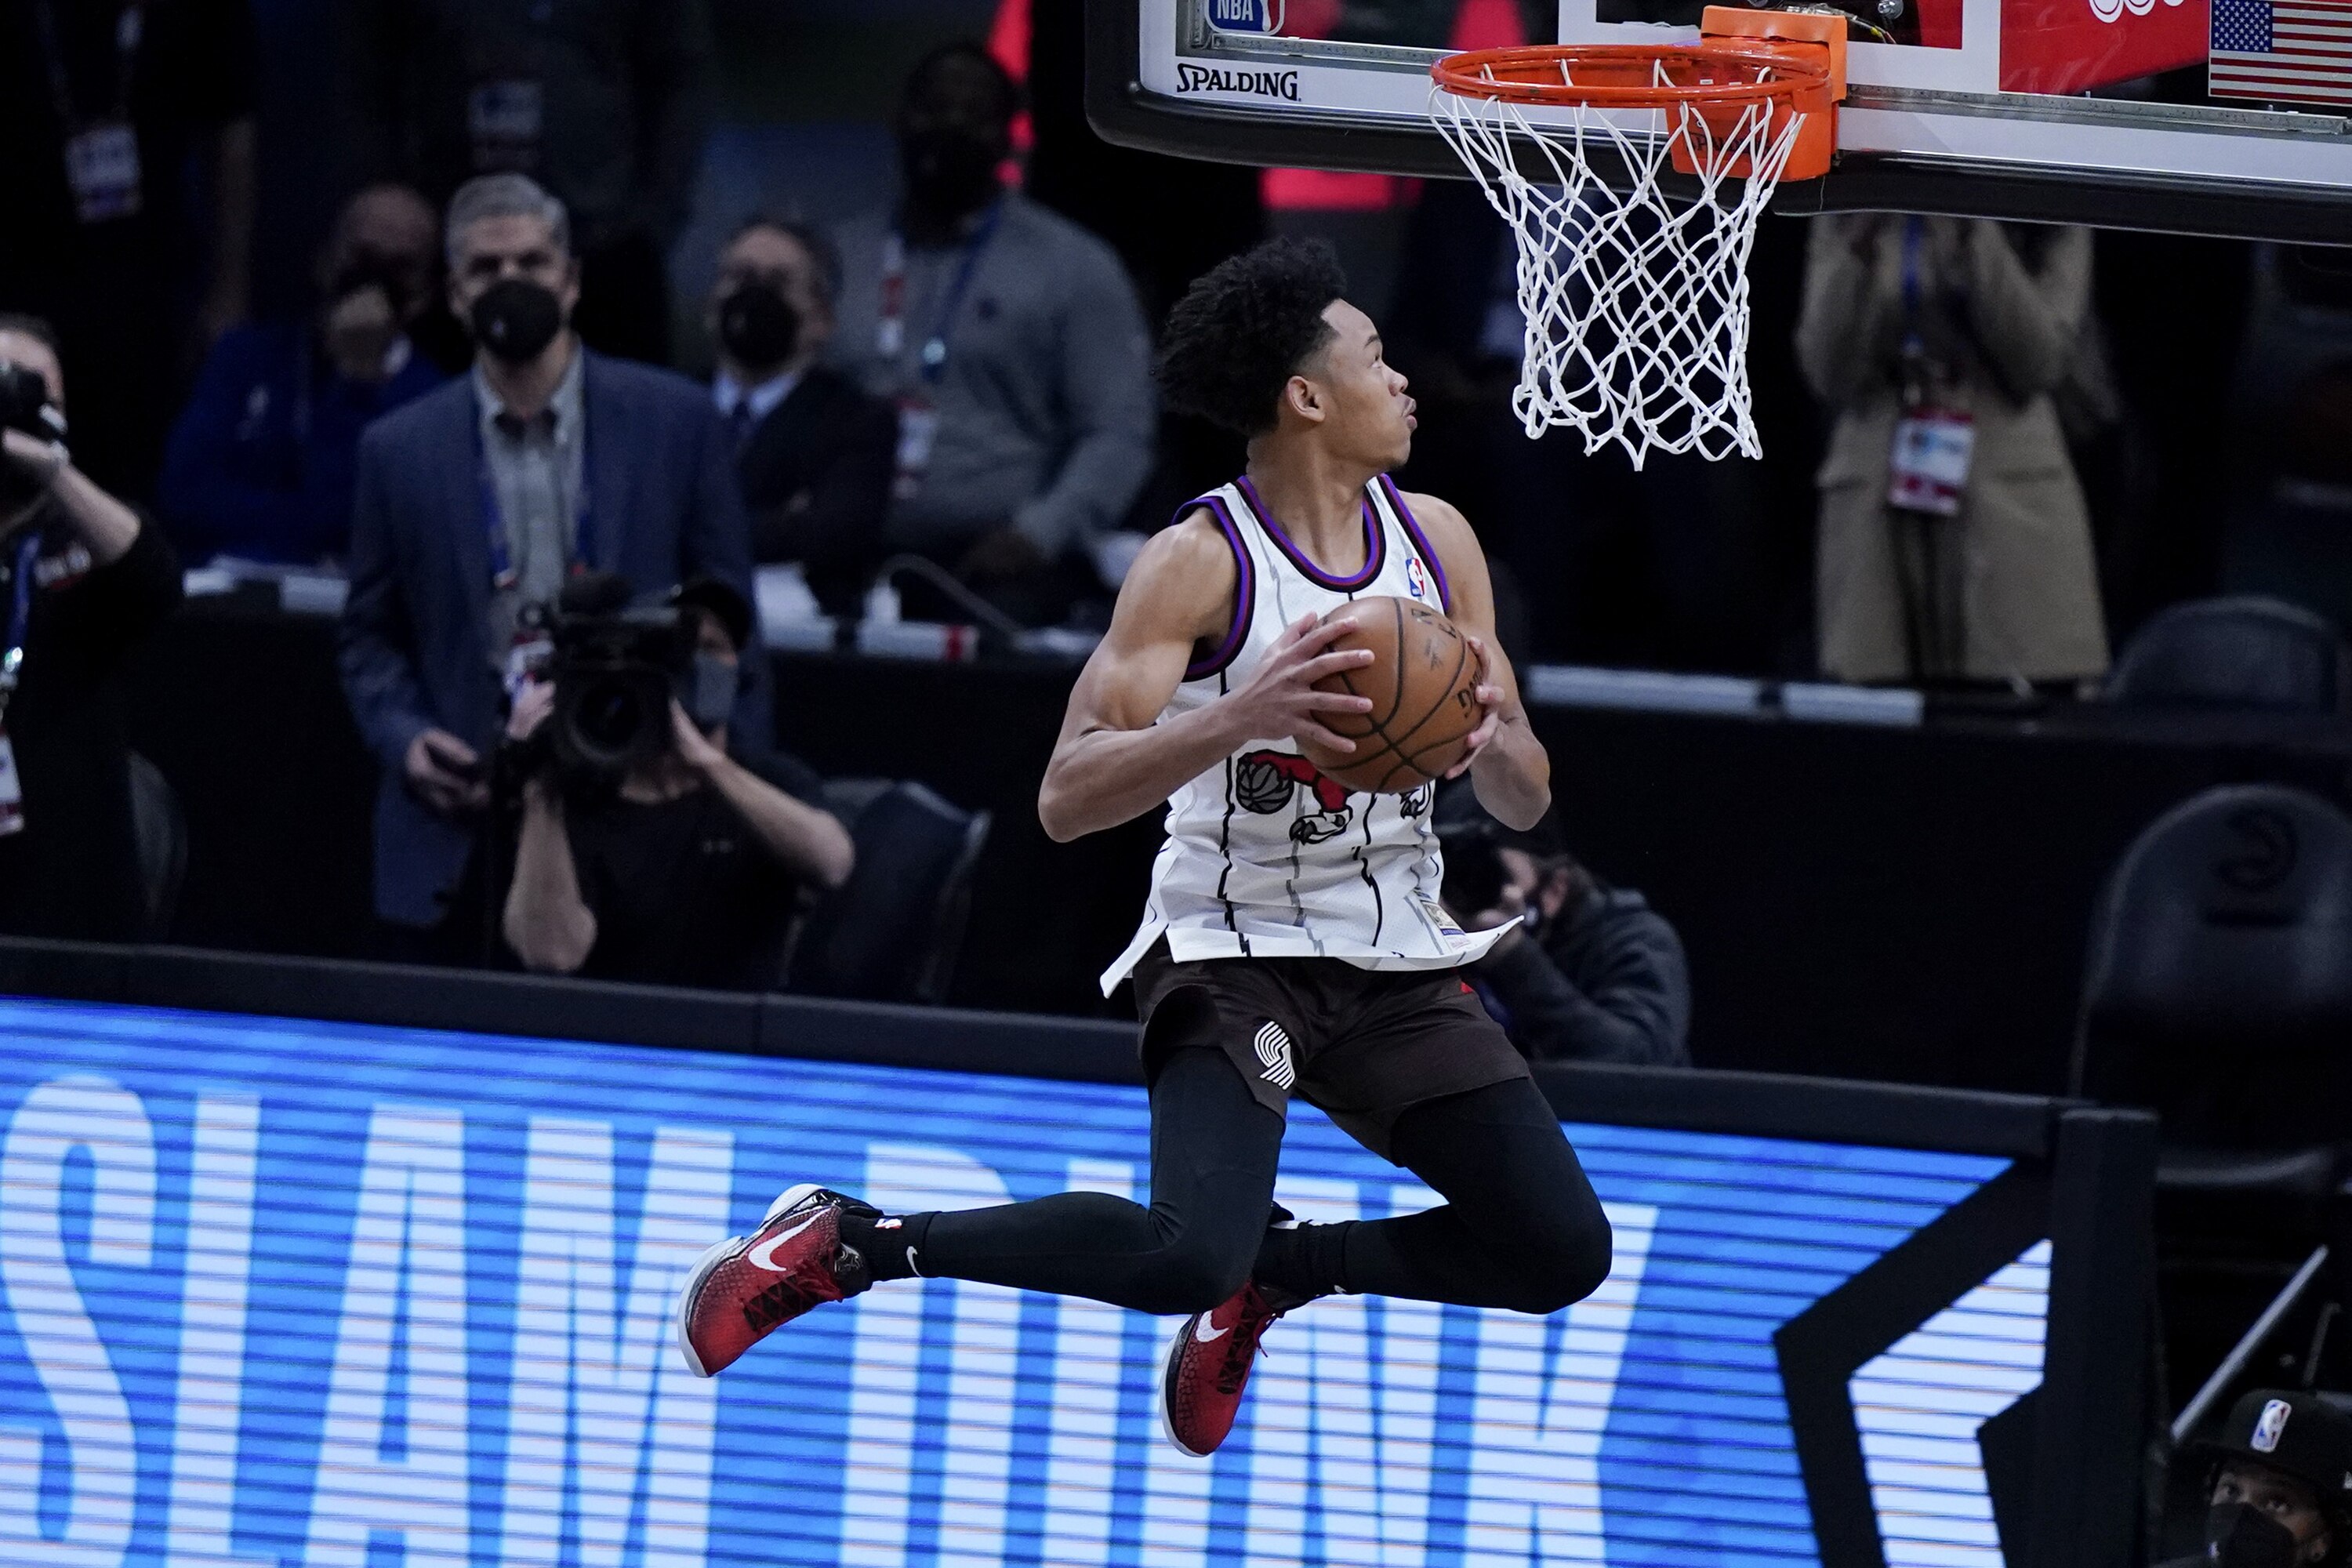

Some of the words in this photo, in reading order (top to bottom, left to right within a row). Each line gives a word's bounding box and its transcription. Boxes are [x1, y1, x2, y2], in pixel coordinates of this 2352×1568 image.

[1217, 0, 1254, 21] NBA
[1177, 63, 1298, 101] SPALDING
[0, 1073, 735, 1568] SLAM
